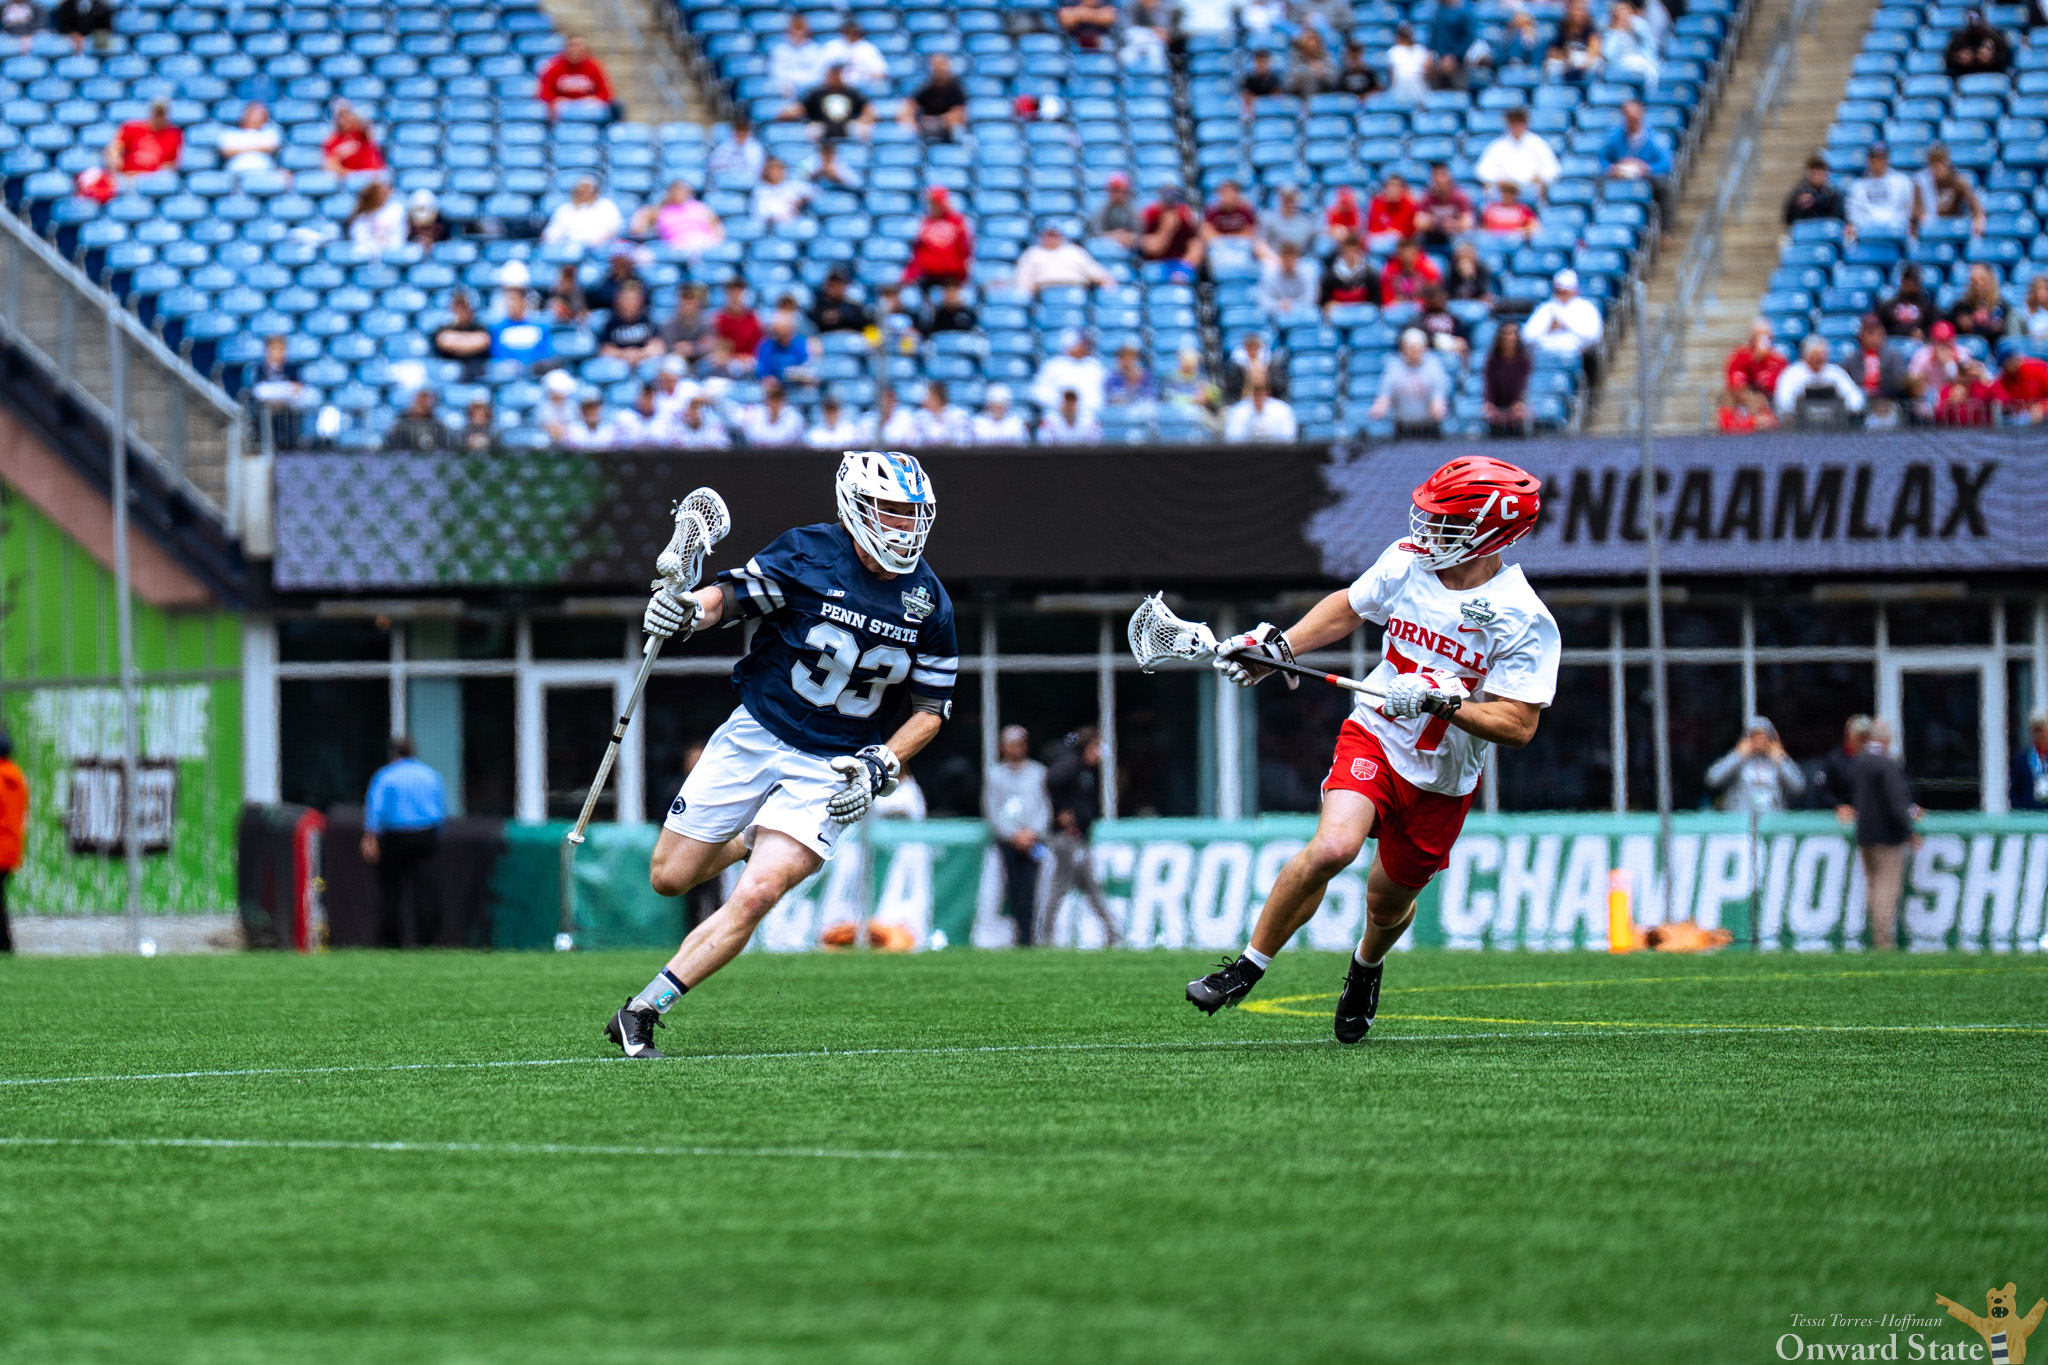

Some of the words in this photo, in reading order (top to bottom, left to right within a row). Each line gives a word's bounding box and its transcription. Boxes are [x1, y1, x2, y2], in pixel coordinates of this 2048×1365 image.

[1500, 495, 1520, 520] C
[820, 601, 868, 629] PENN
[868, 618, 919, 643] STATE
[1387, 615, 1489, 677] ORNELL
[790, 620, 912, 719] 33
[1440, 833, 2048, 952] CHAMPIOSHI
